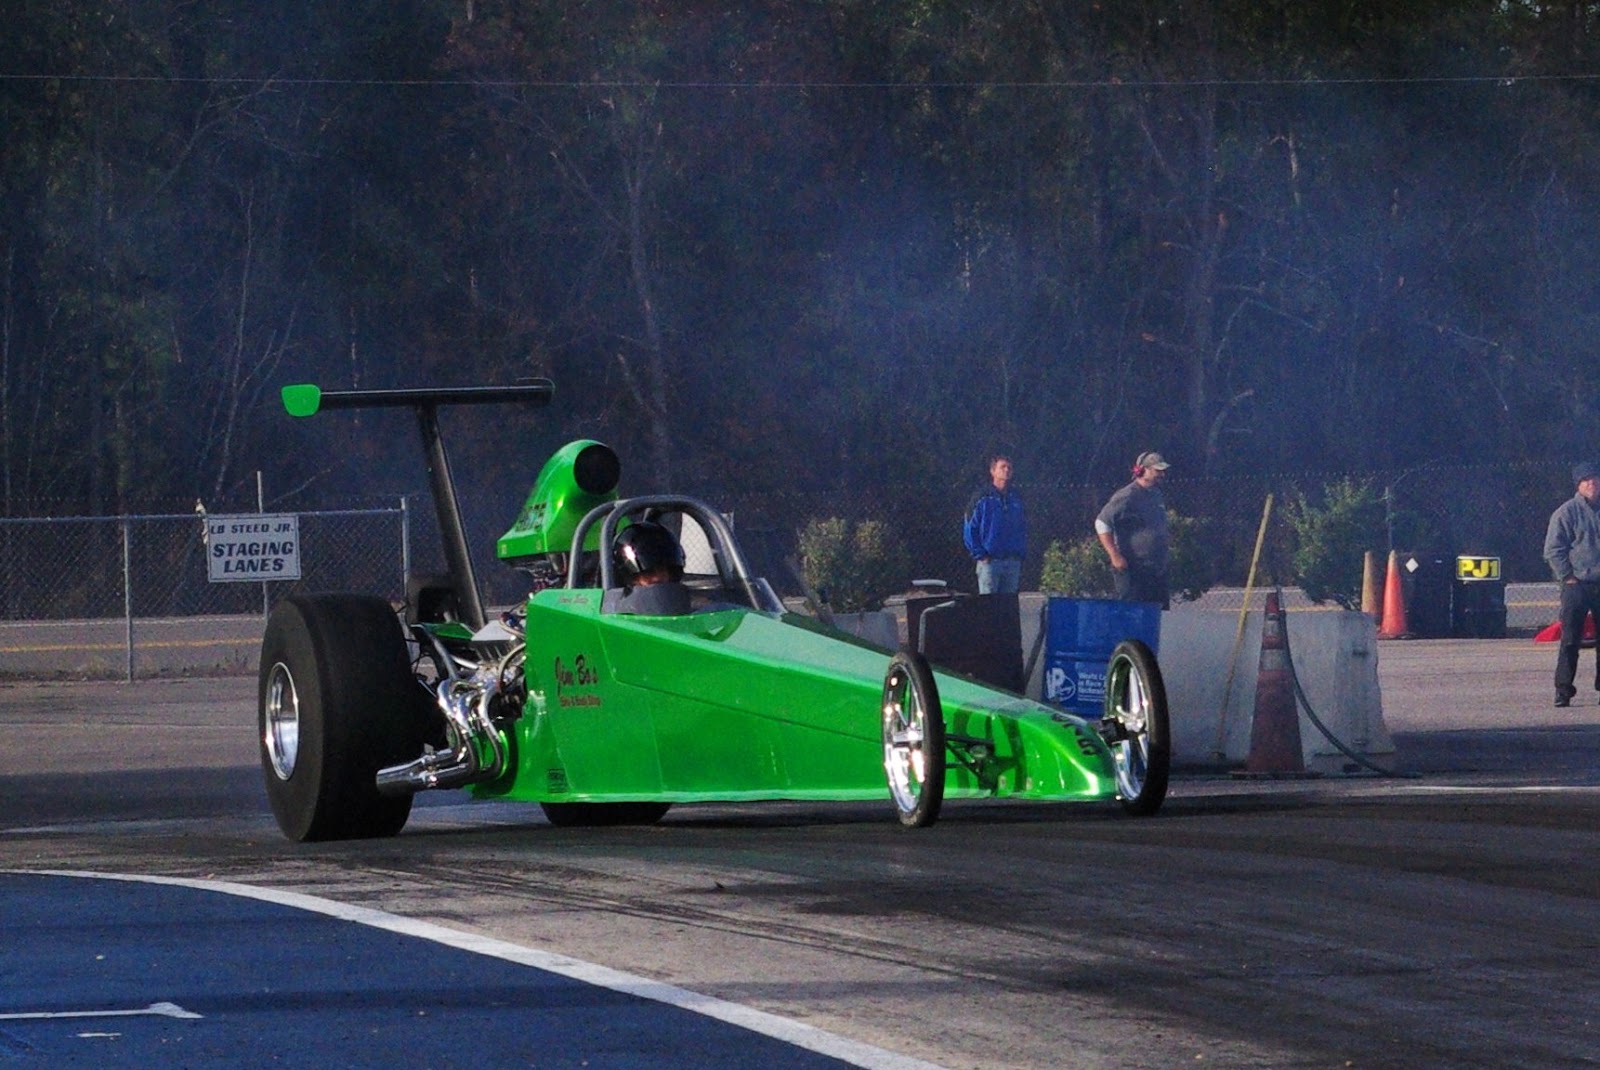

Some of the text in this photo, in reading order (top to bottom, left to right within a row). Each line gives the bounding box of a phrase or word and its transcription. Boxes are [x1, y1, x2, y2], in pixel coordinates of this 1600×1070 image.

[210, 525, 225, 535] LB
[231, 523, 269, 534] STEED
[213, 541, 294, 558] STAGING
[224, 558, 284, 573] LANES
[1458, 559, 1499, 578] PJ1
